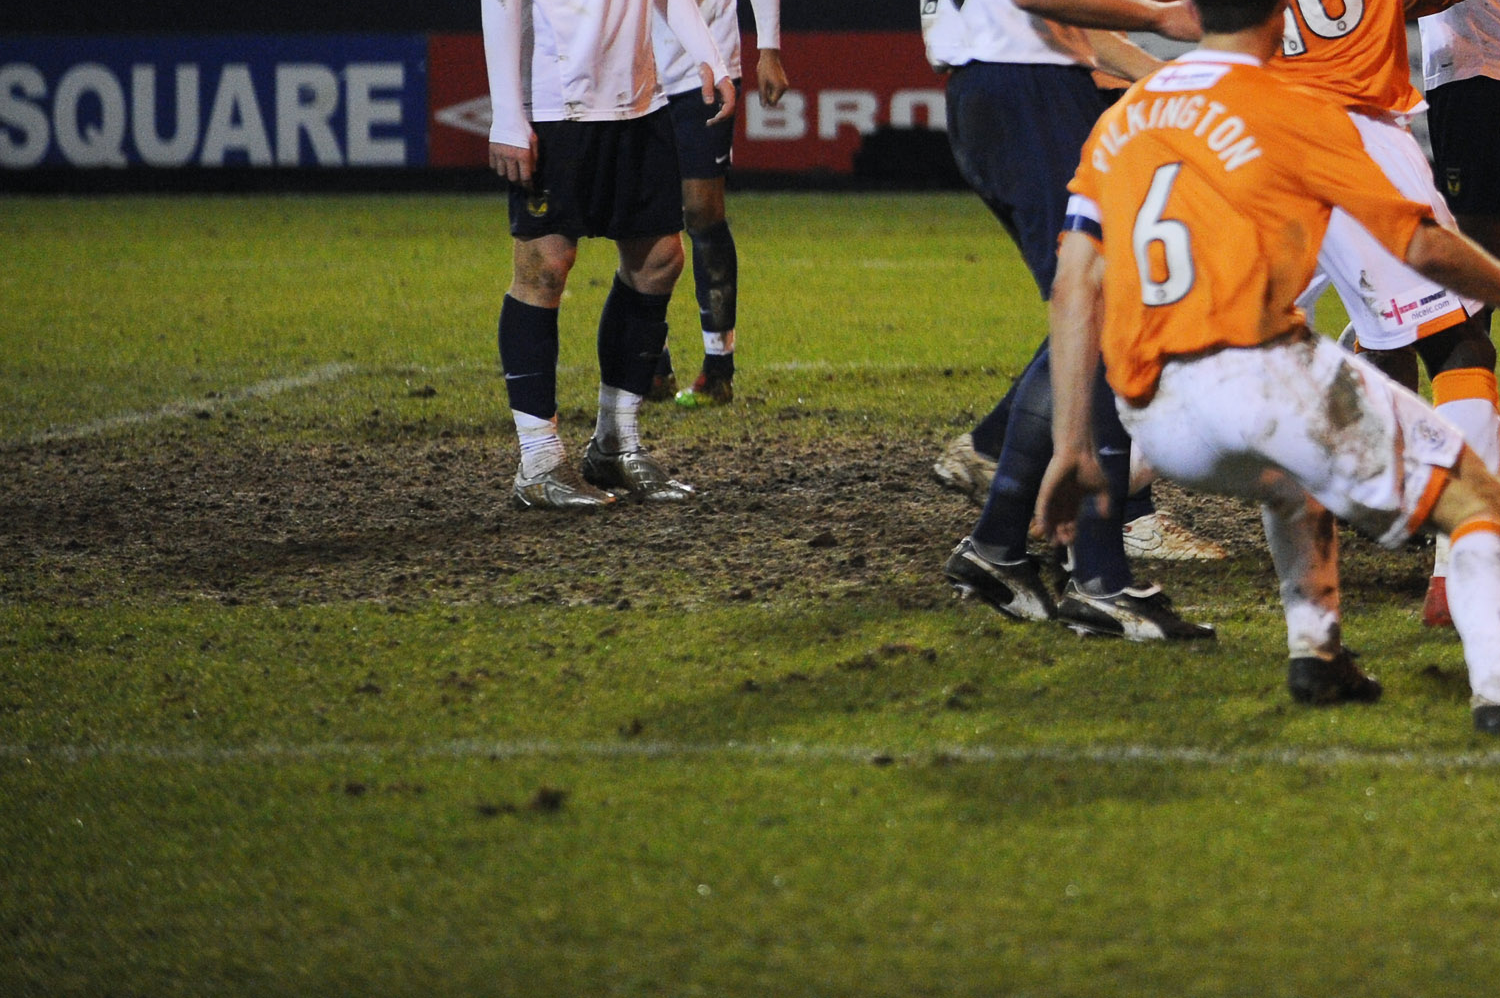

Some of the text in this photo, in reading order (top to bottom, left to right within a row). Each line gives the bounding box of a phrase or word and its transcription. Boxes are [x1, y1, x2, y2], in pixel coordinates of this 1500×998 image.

[0, 62, 406, 170] SQUARE
[1092, 94, 1262, 173] PILKINGTON
[1132, 160, 1196, 307] 6
